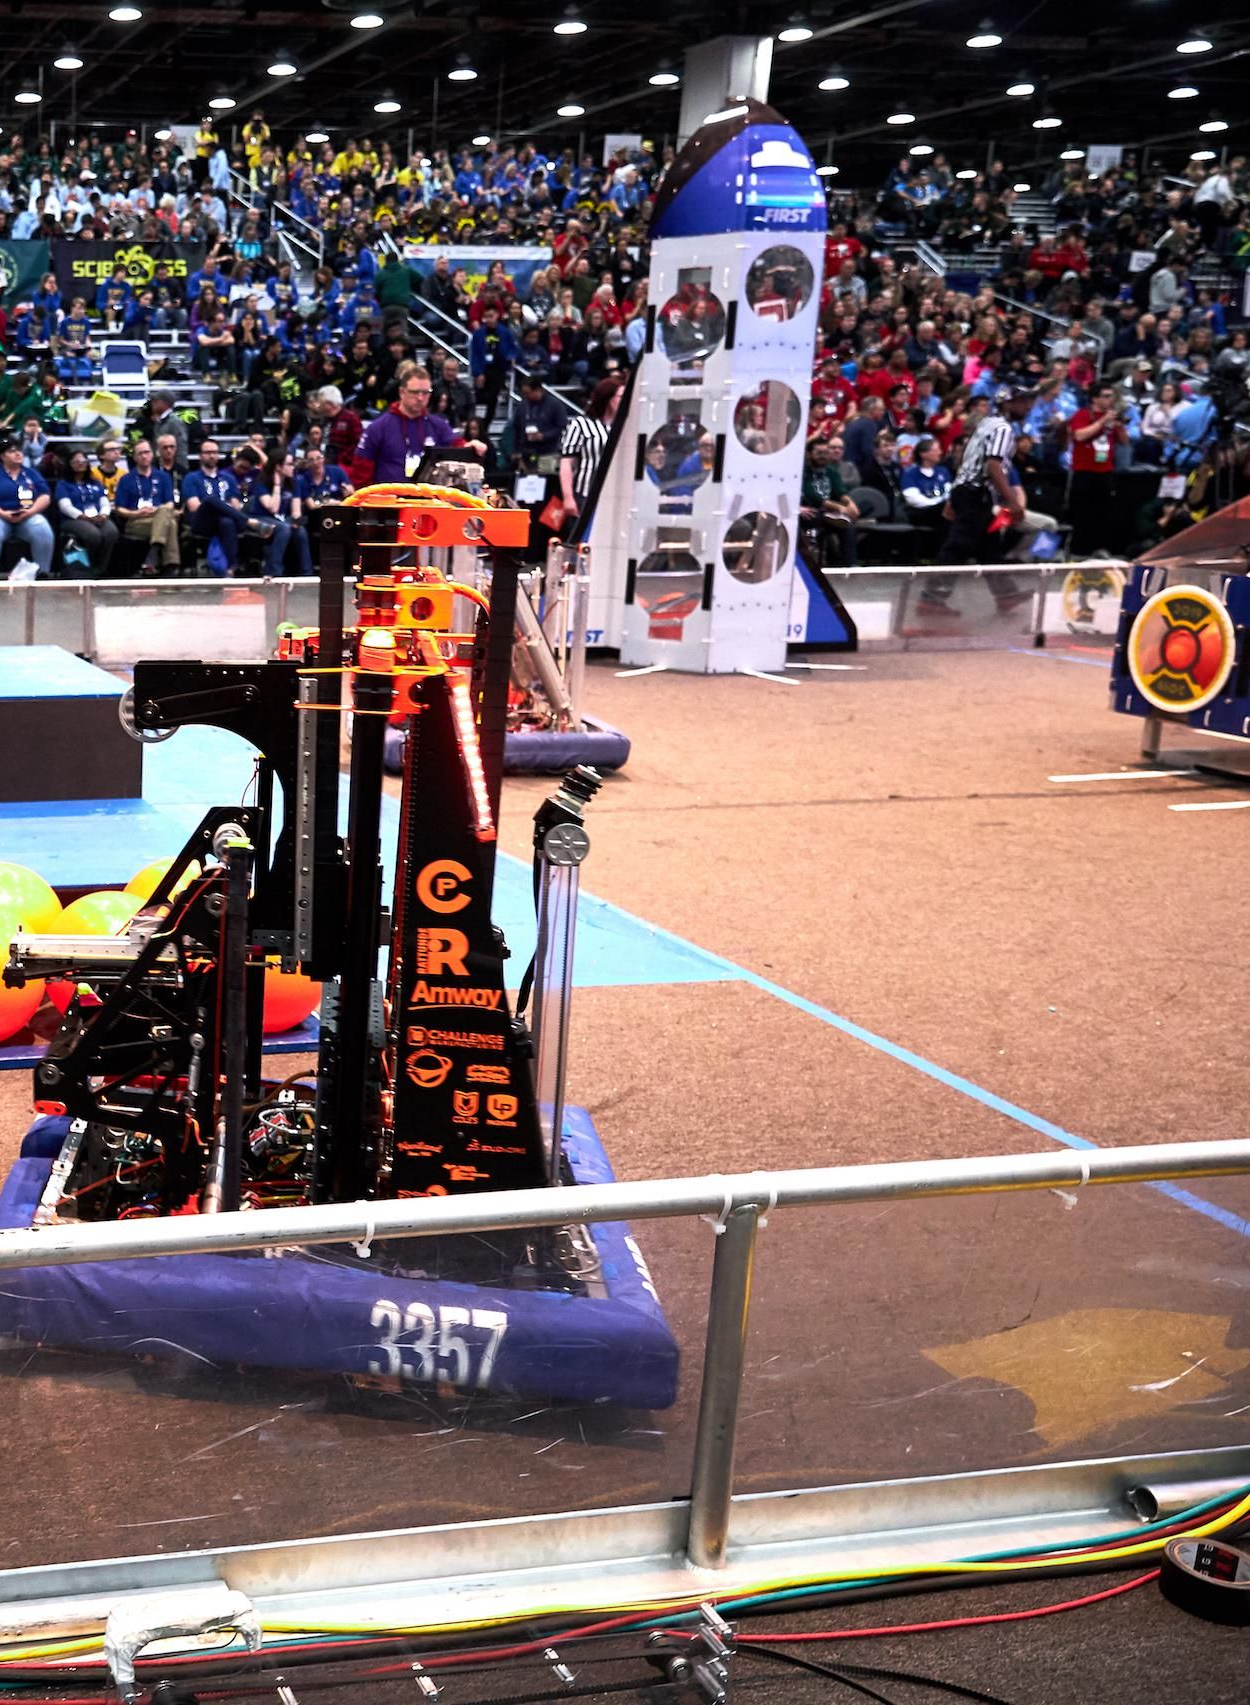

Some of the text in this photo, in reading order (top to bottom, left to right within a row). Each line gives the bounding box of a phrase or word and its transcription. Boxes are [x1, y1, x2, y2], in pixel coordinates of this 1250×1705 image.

[763, 208, 812, 223] FIRST
[411, 980, 502, 1010] Amway
[429, 1029, 505, 1045] CHALLENGE
[369, 1299, 508, 1389] 3357
